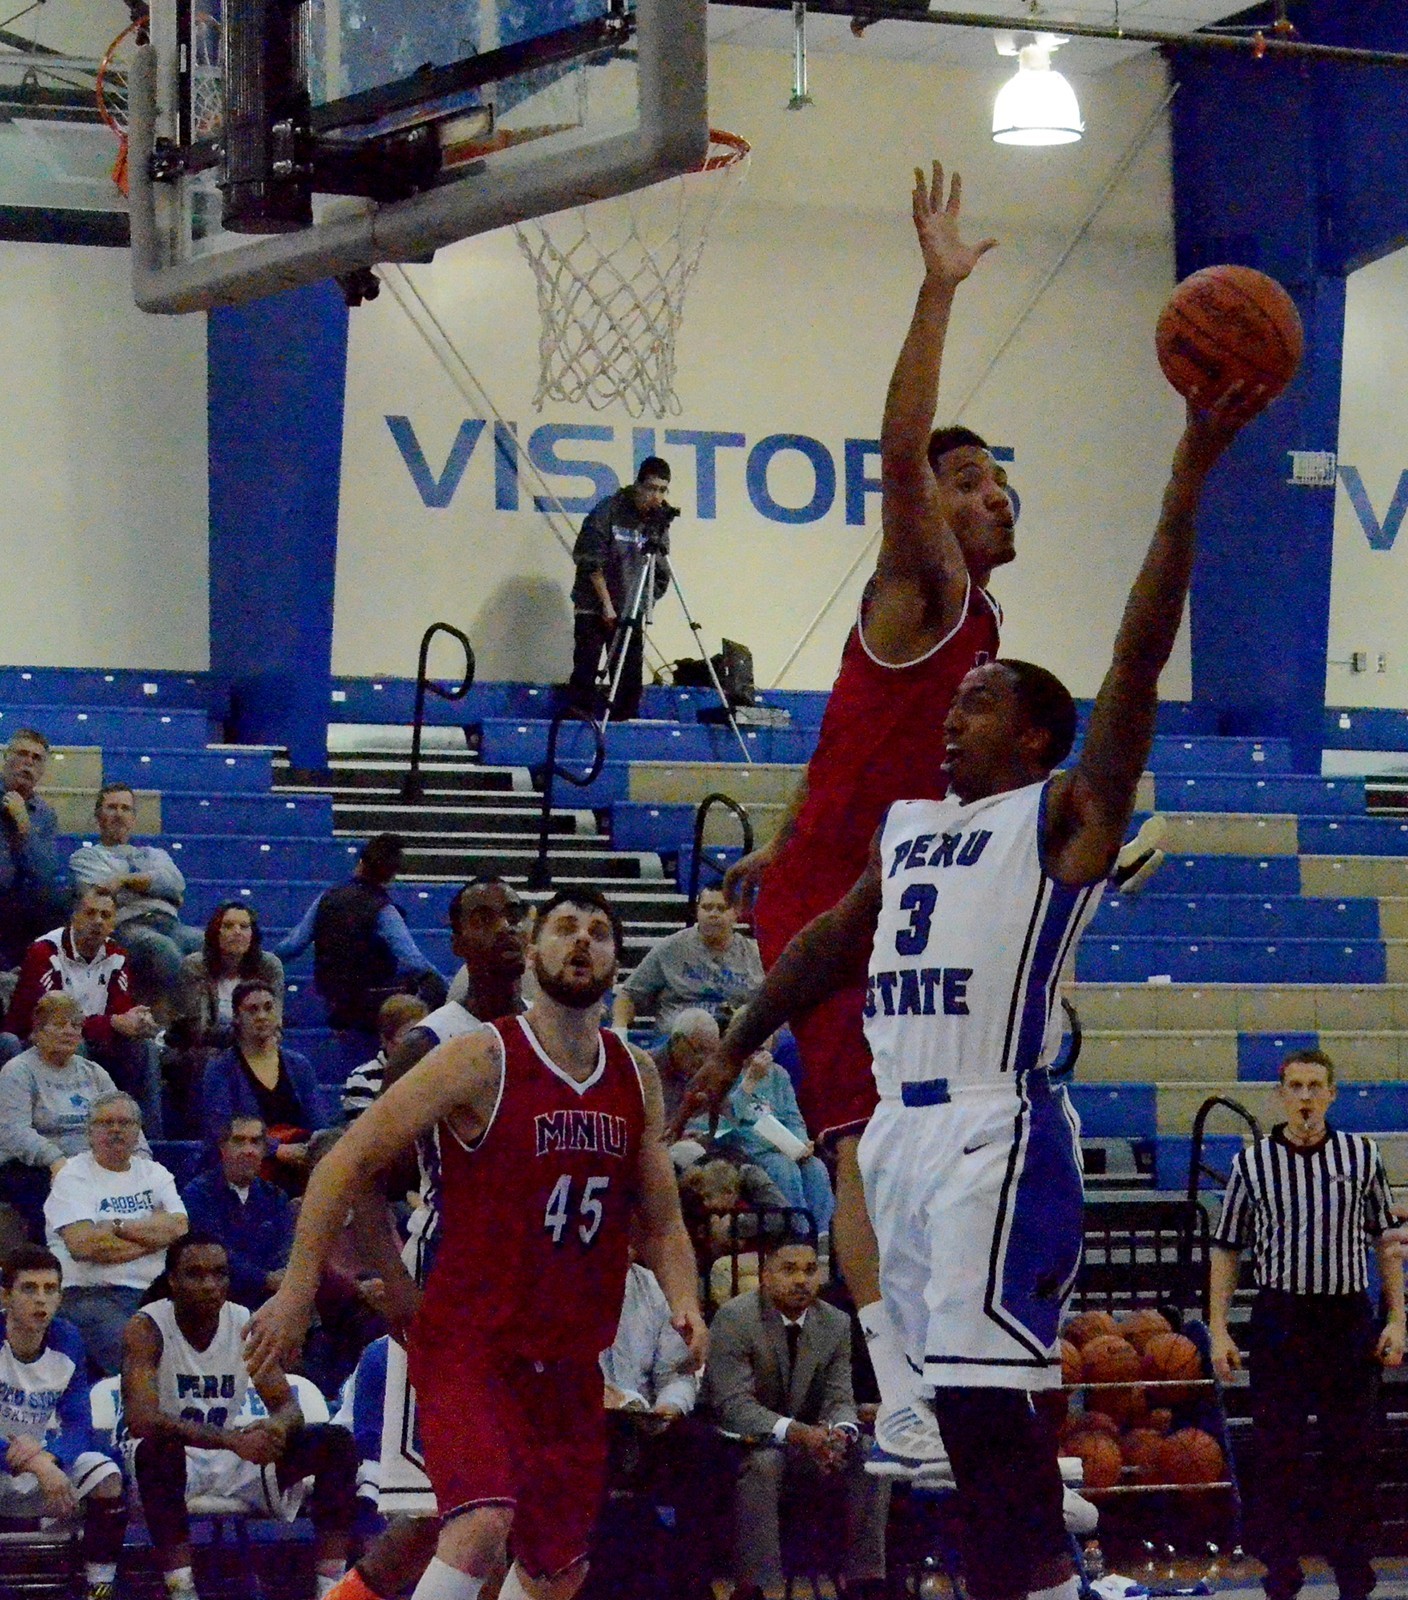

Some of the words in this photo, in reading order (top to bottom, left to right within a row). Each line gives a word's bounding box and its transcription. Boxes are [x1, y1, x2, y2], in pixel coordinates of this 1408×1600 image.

[384, 415, 1021, 526] VISITO
[888, 829, 993, 879] PERU
[895, 883, 938, 956] 3
[863, 967, 973, 1018] STATE
[534, 1109, 627, 1158] MNU
[544, 1173, 609, 1244] 45
